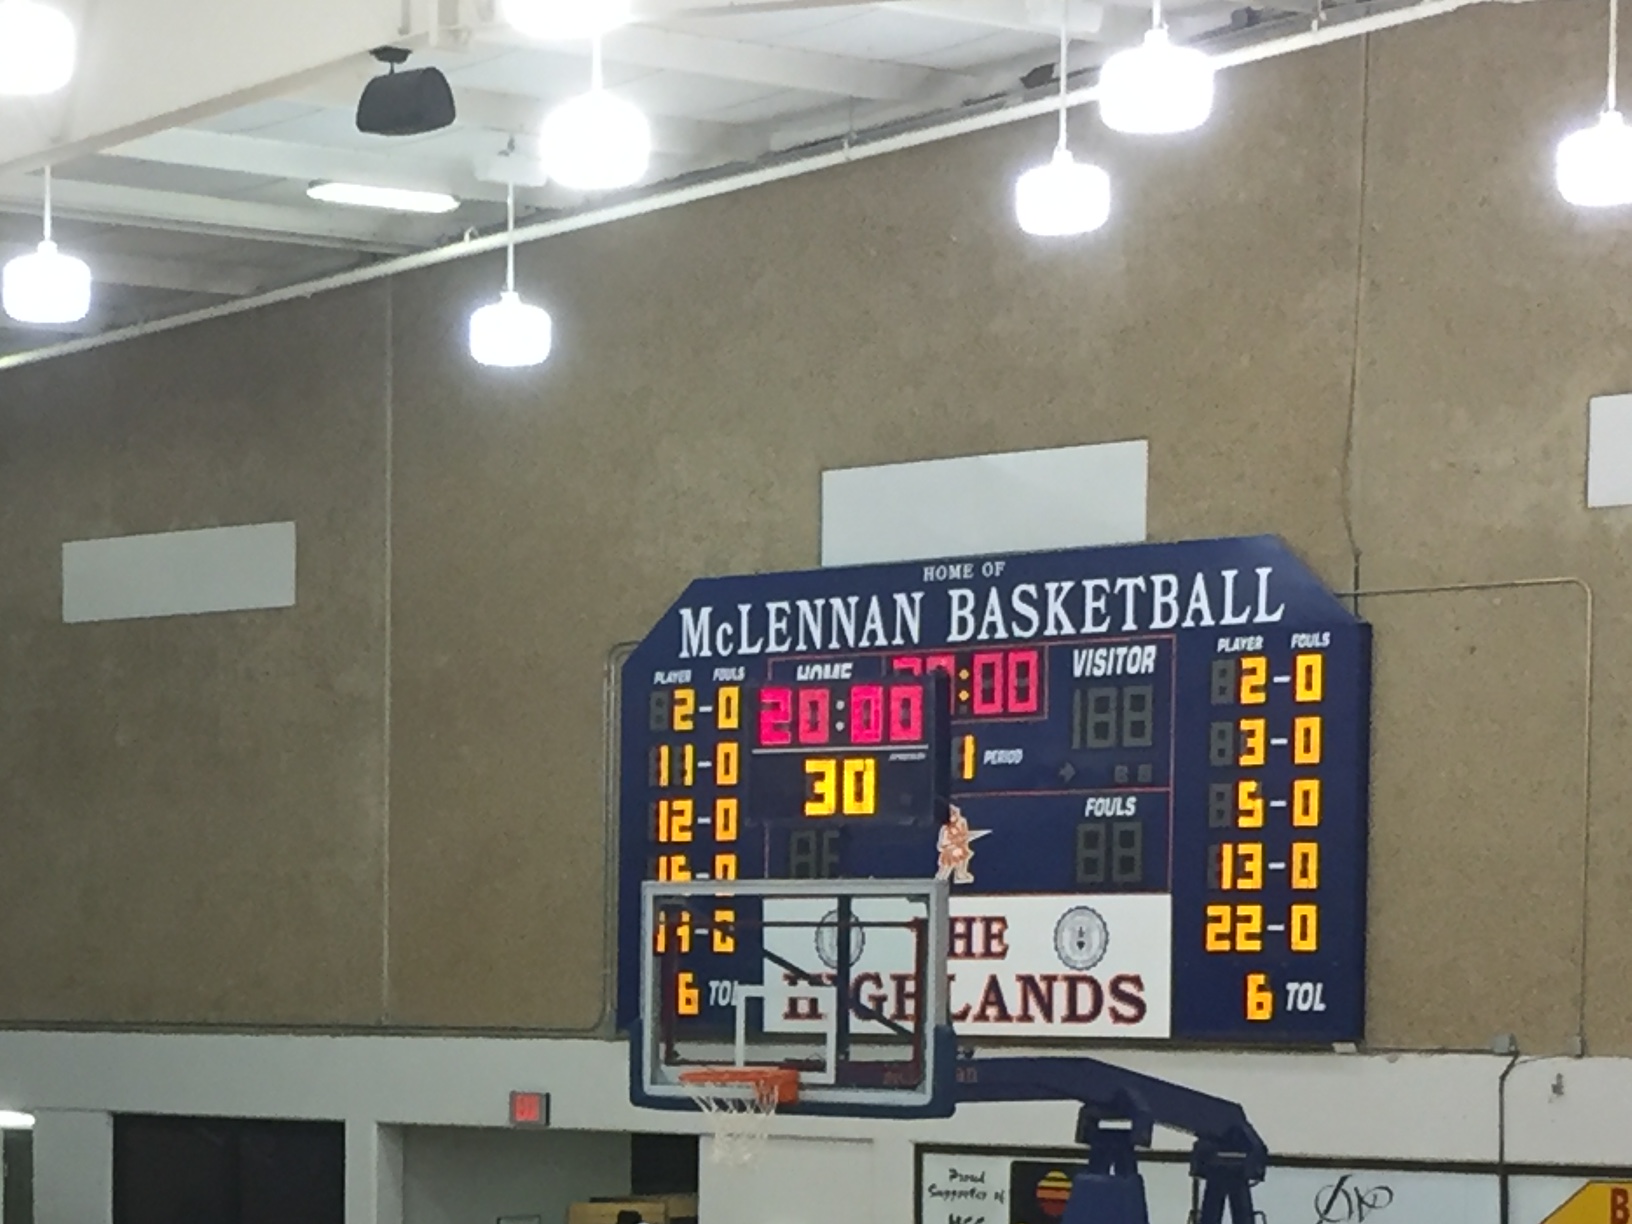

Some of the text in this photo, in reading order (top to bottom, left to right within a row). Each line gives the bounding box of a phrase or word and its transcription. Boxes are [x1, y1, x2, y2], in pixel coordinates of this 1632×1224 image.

[923, 561, 1006, 582] HOME OF
[678, 566, 1285, 659] McLENNAN BASKETBALL
[1218, 635, 1264, 652] PLAYER
[1291, 632, 1330, 649] FOULS
[796, 662, 854, 680] HOME
[1071, 645, 1157, 678] VISITOR
[653, 669, 692, 685] PLAYER
[713, 666, 746, 682] FOULS
[759, 685, 924, 746] 20:00
[983, 749, 1023, 765] PERIOD
[804, 758, 877, 816] 30
[1084, 797, 1137, 817] FOULS
[910, 916, 1010, 960] HE
[677, 971, 699, 1016] 6
[1245, 972, 1326, 1021] 6 TOL
[948, 1168, 986, 1184] Proud
[994, 1188, 1006, 1204] of
